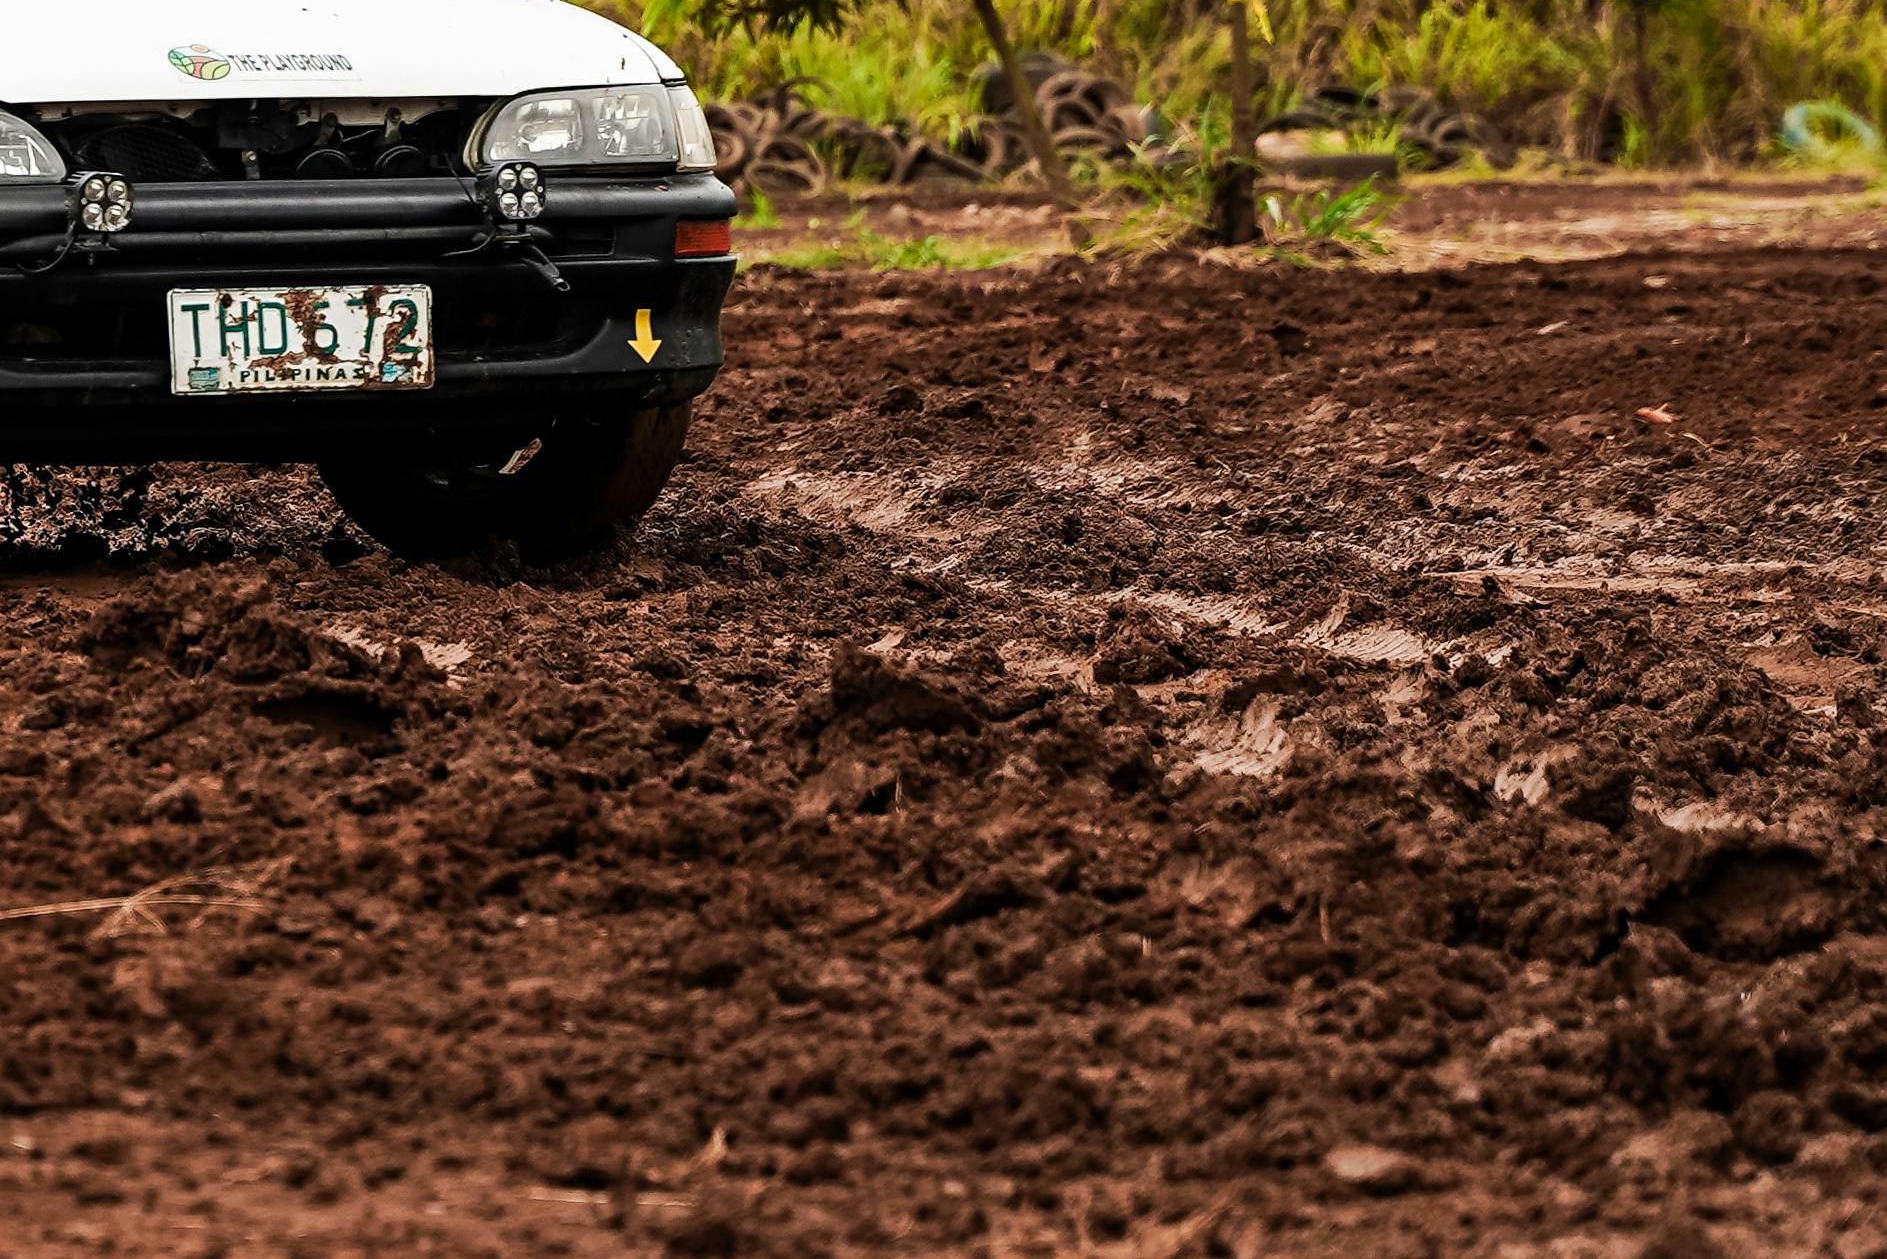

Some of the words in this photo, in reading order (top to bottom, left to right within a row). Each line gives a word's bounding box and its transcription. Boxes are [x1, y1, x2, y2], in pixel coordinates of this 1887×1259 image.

[226, 54, 262, 72] THE
[261, 54, 353, 72] PLAYGROUND
[180, 300, 288, 358] THD
[239, 366, 365, 383] PILPINAS
